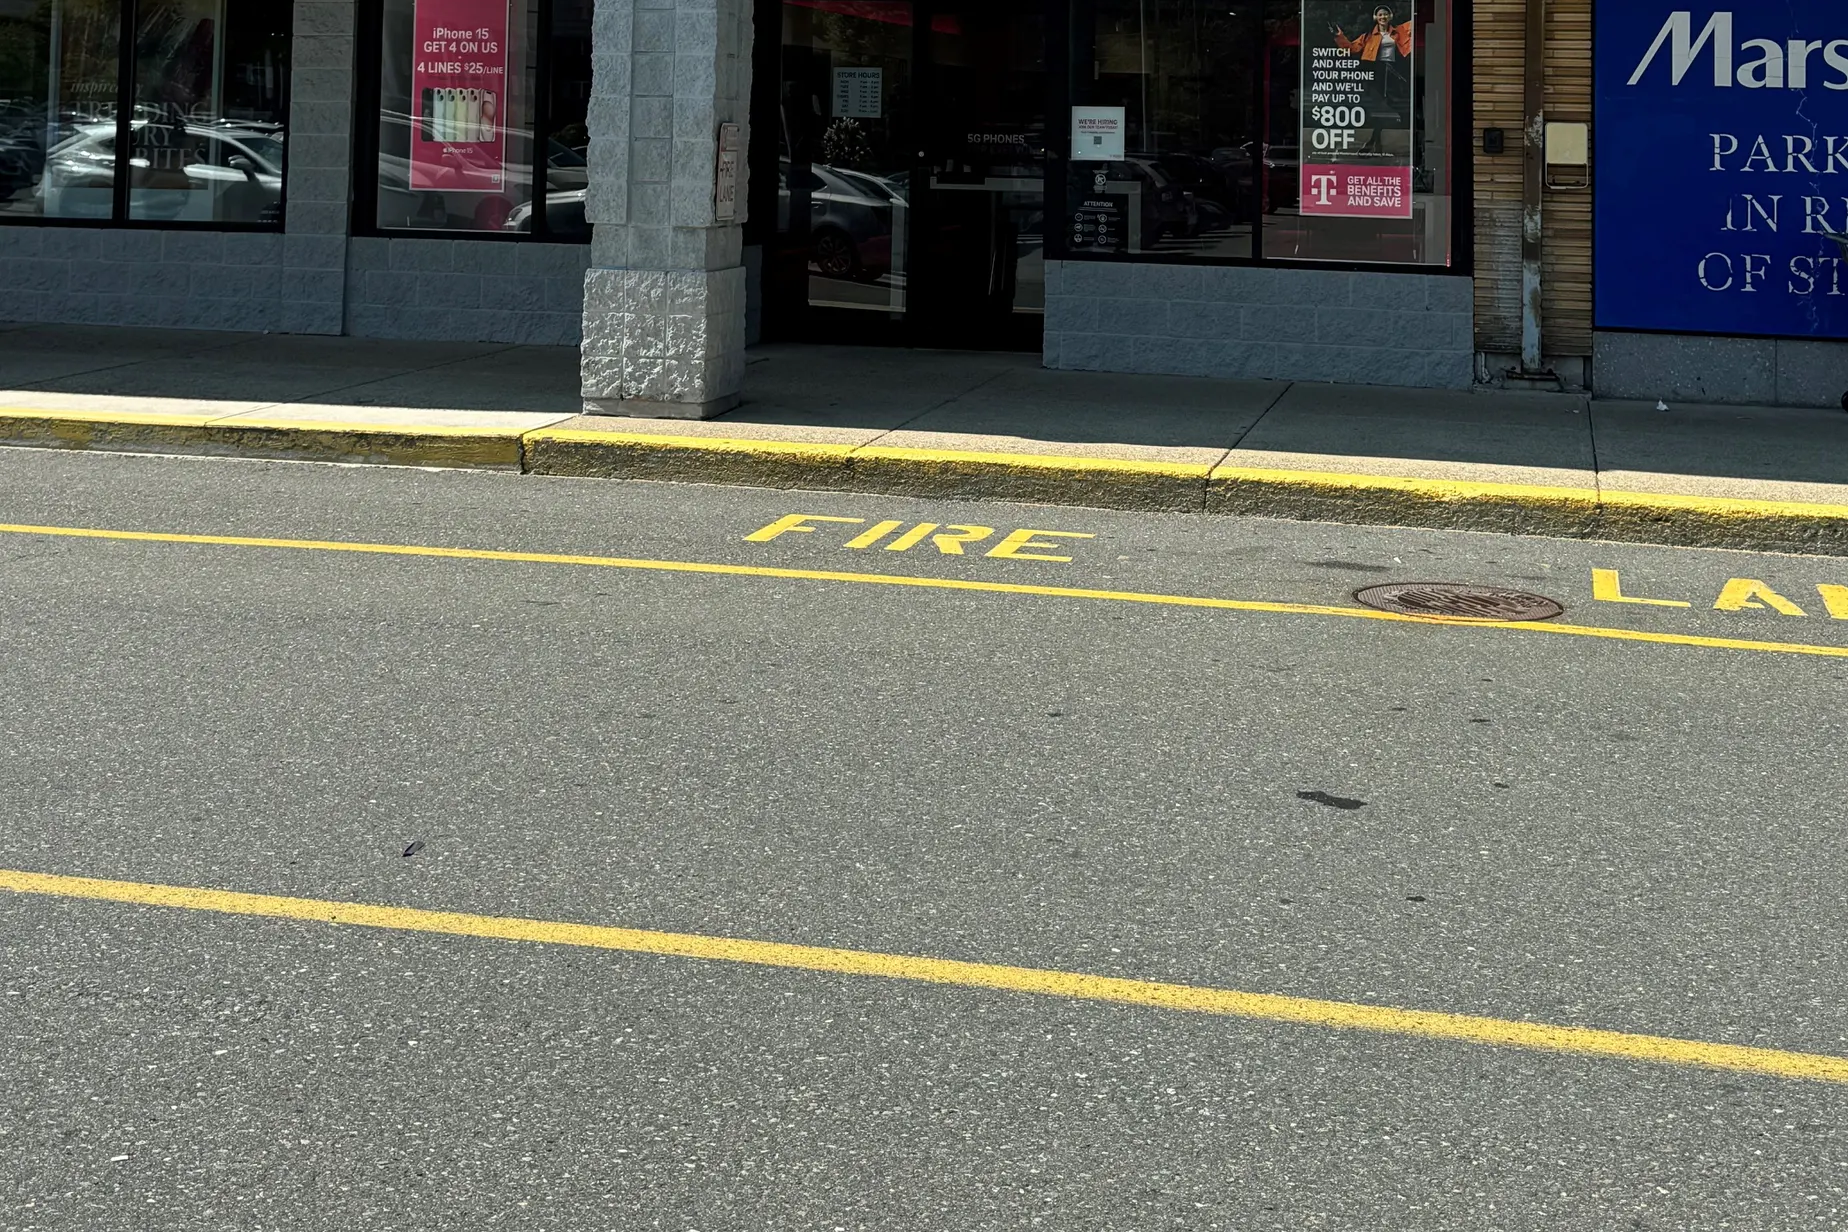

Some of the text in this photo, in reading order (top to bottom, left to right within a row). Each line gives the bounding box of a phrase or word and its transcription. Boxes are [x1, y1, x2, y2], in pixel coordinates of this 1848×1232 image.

[432, 27, 489, 40] iPhone 15
[423, 41, 498, 54] GET 4 ON US
[1312, 47, 1351, 57] SWITCH
[1626, 10, 1848, 91] Mars
[417, 62, 504, 75] 4 LINES $25/LINE
[1312, 59, 1360, 69] AND KEEP
[837, 71, 880, 79] STORE HOURS
[1312, 70, 1375, 81] YOUR PHONE
[1312, 82, 1364, 92] AND WE'LL
[1312, 94, 1361, 103] PAY UP TO
[1312, 106, 1366, 128] $800
[967, 133, 1025, 144] 5G PHONES
[1312, 128, 1355, 150] OFF
[1709, 133, 1848, 174] PARK
[1347, 176, 1402, 186] GET ALL THE
[1347, 185, 1402, 197] BENEFITS
[1083, 200, 1114, 208] ATTENTION
[1347, 196, 1402, 207] AND SAVE
[1800, 195, 1848, 235] R
[1698, 252, 1772, 292] OF
[741, 513, 1096, 562] FIRE
